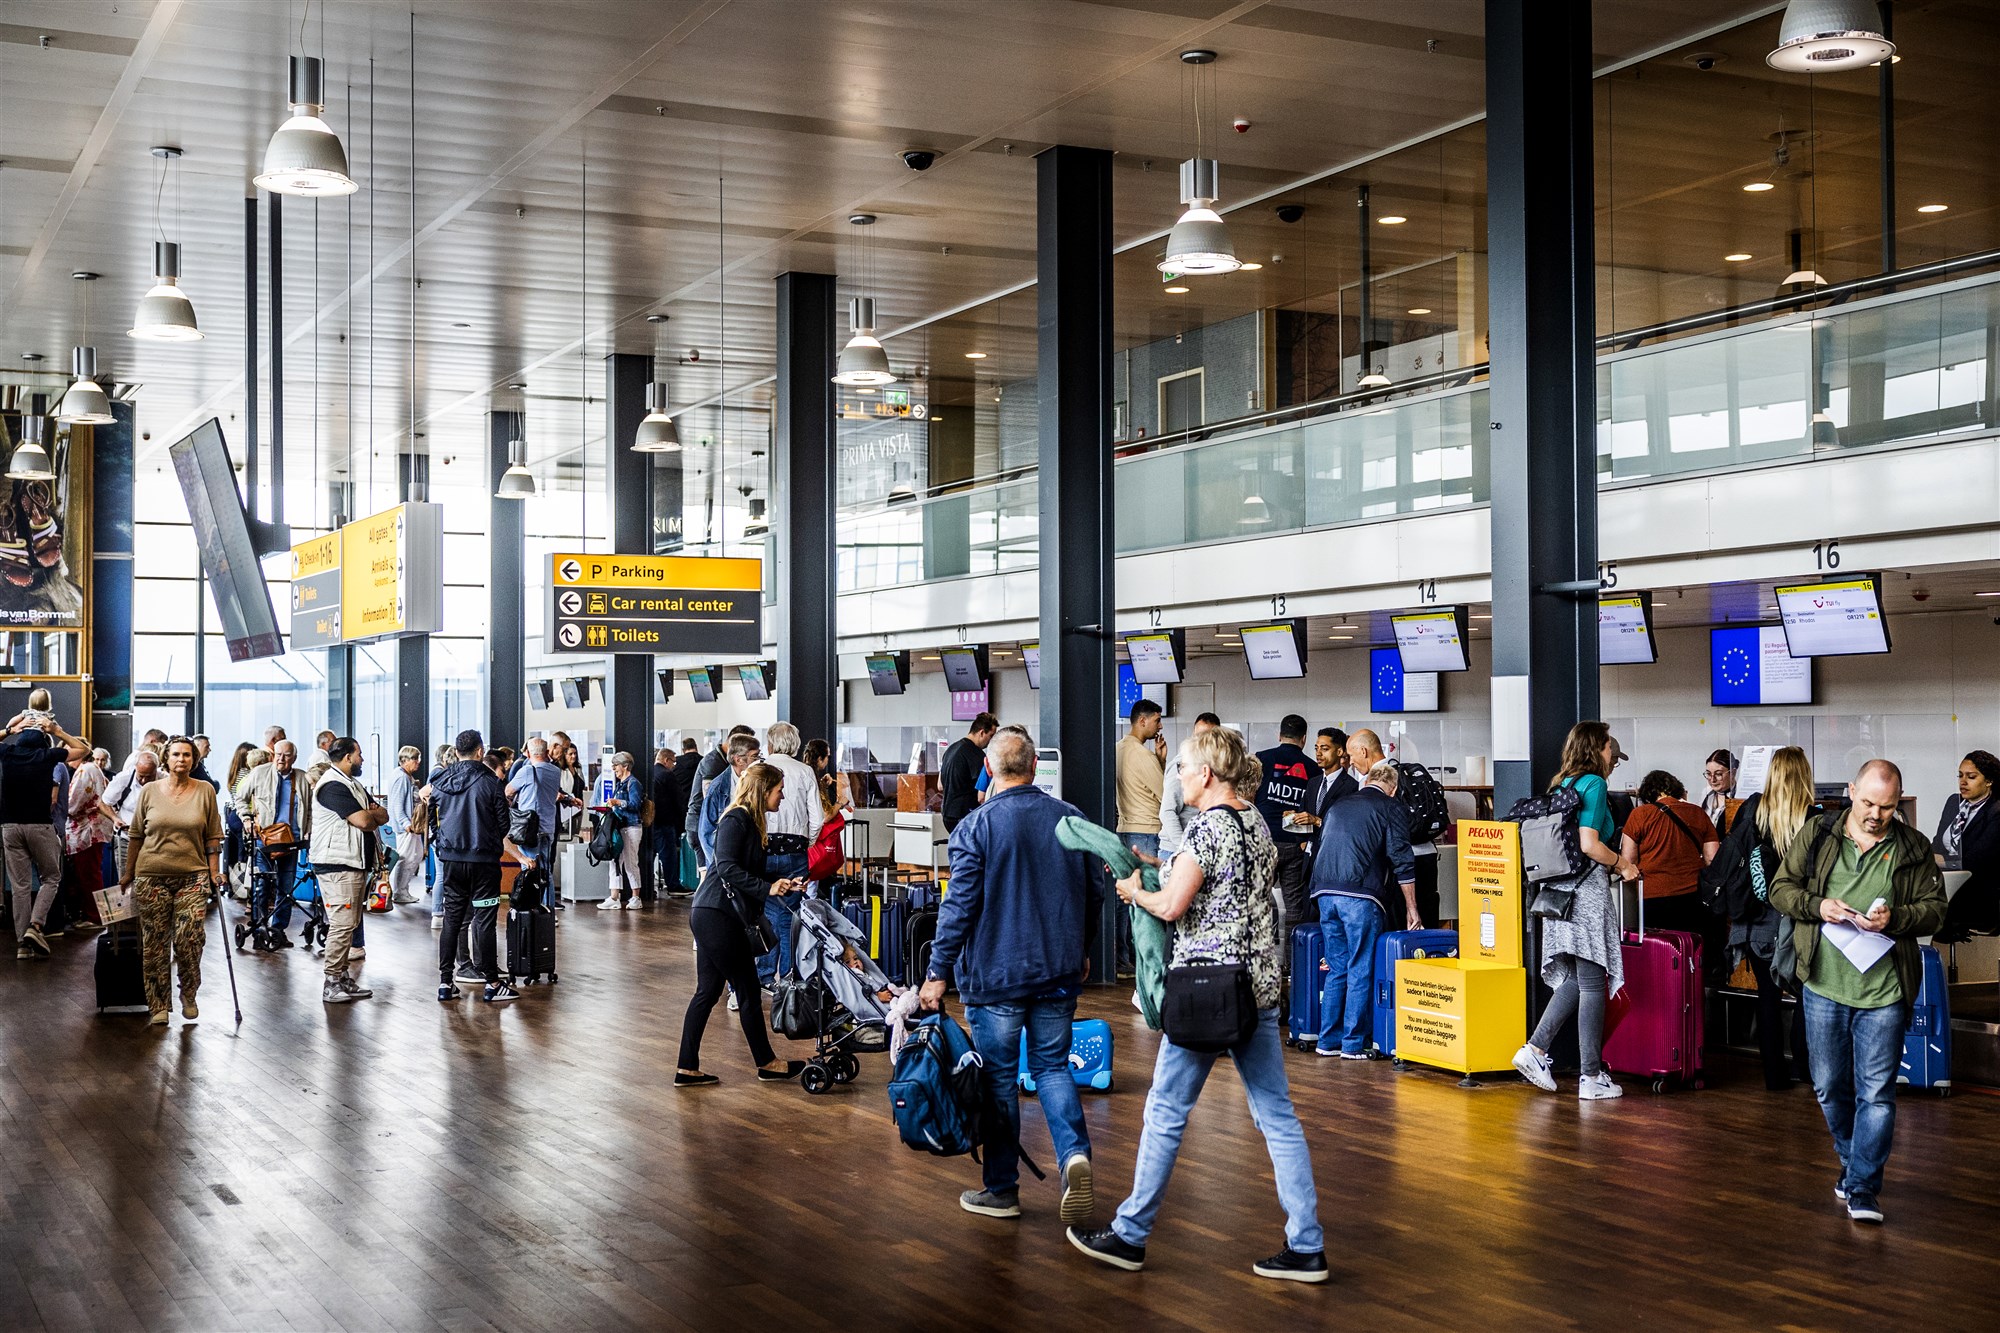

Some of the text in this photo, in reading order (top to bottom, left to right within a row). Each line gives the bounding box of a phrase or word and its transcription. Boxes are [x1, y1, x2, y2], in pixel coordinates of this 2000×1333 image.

[843, 432, 911, 468] PRIMA VISTA
[376, 526, 388, 544] gates
[320, 541, 332, 566] 1-16
[1813, 542, 1840, 570] 16
[372, 555, 389, 574] Arrivals
[592, 565, 664, 581] P Parking
[1418, 581, 1436, 603] 14
[1862, 581, 1872, 591] 16
[611, 597, 733, 612] Car rental center
[1271, 596, 1286, 616] 13
[9, 610, 28, 618] van
[28, 609, 76, 619] Bommel
[362, 604, 388, 624] Information
[1149, 608, 1161, 626] 12
[611, 629, 660, 643] Toilets
[957, 626, 967, 643] 10
[1468, 827, 1505, 840] PEGASUS
[1407, 988, 1422, 996] sadece
[1404, 1024, 1413, 1032] only
[1423, 1027, 1436, 1036] cabin
[1436, 1029, 1456, 1041] baggage
[1423, 1018, 1438, 1027] allowed
[1444, 1022, 1453, 1030] take
